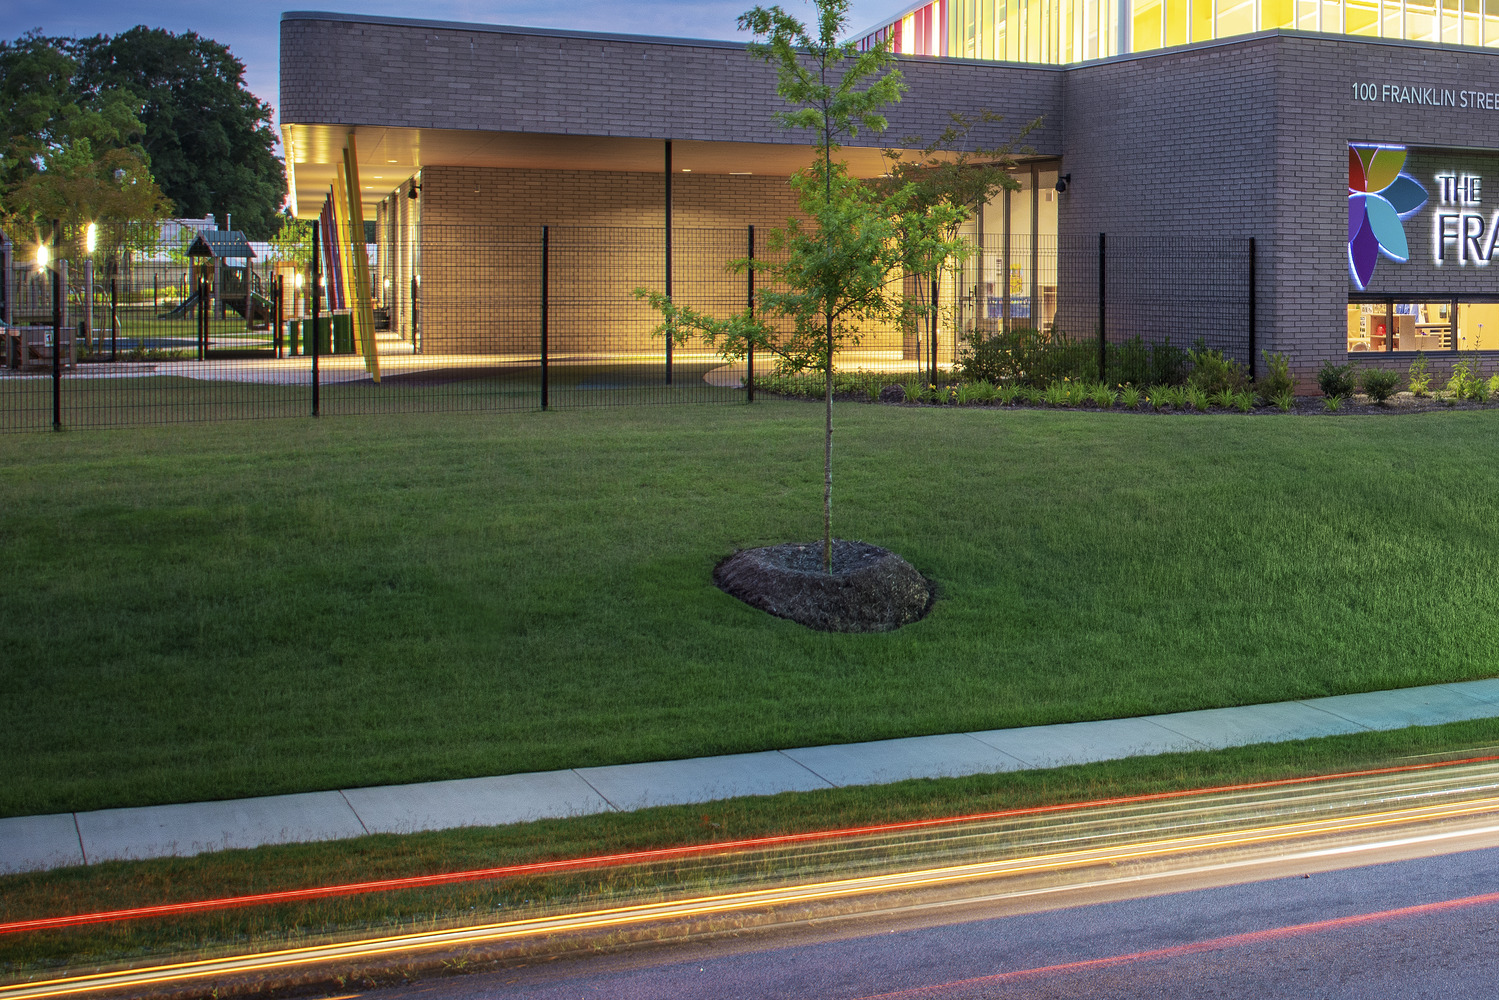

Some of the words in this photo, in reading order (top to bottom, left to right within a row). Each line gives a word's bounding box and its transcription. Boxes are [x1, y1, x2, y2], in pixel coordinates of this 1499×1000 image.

[1352, 82, 1378, 101] 100
[1382, 84, 1456, 107] FRANKLIN
[1436, 173, 1483, 204] THE
